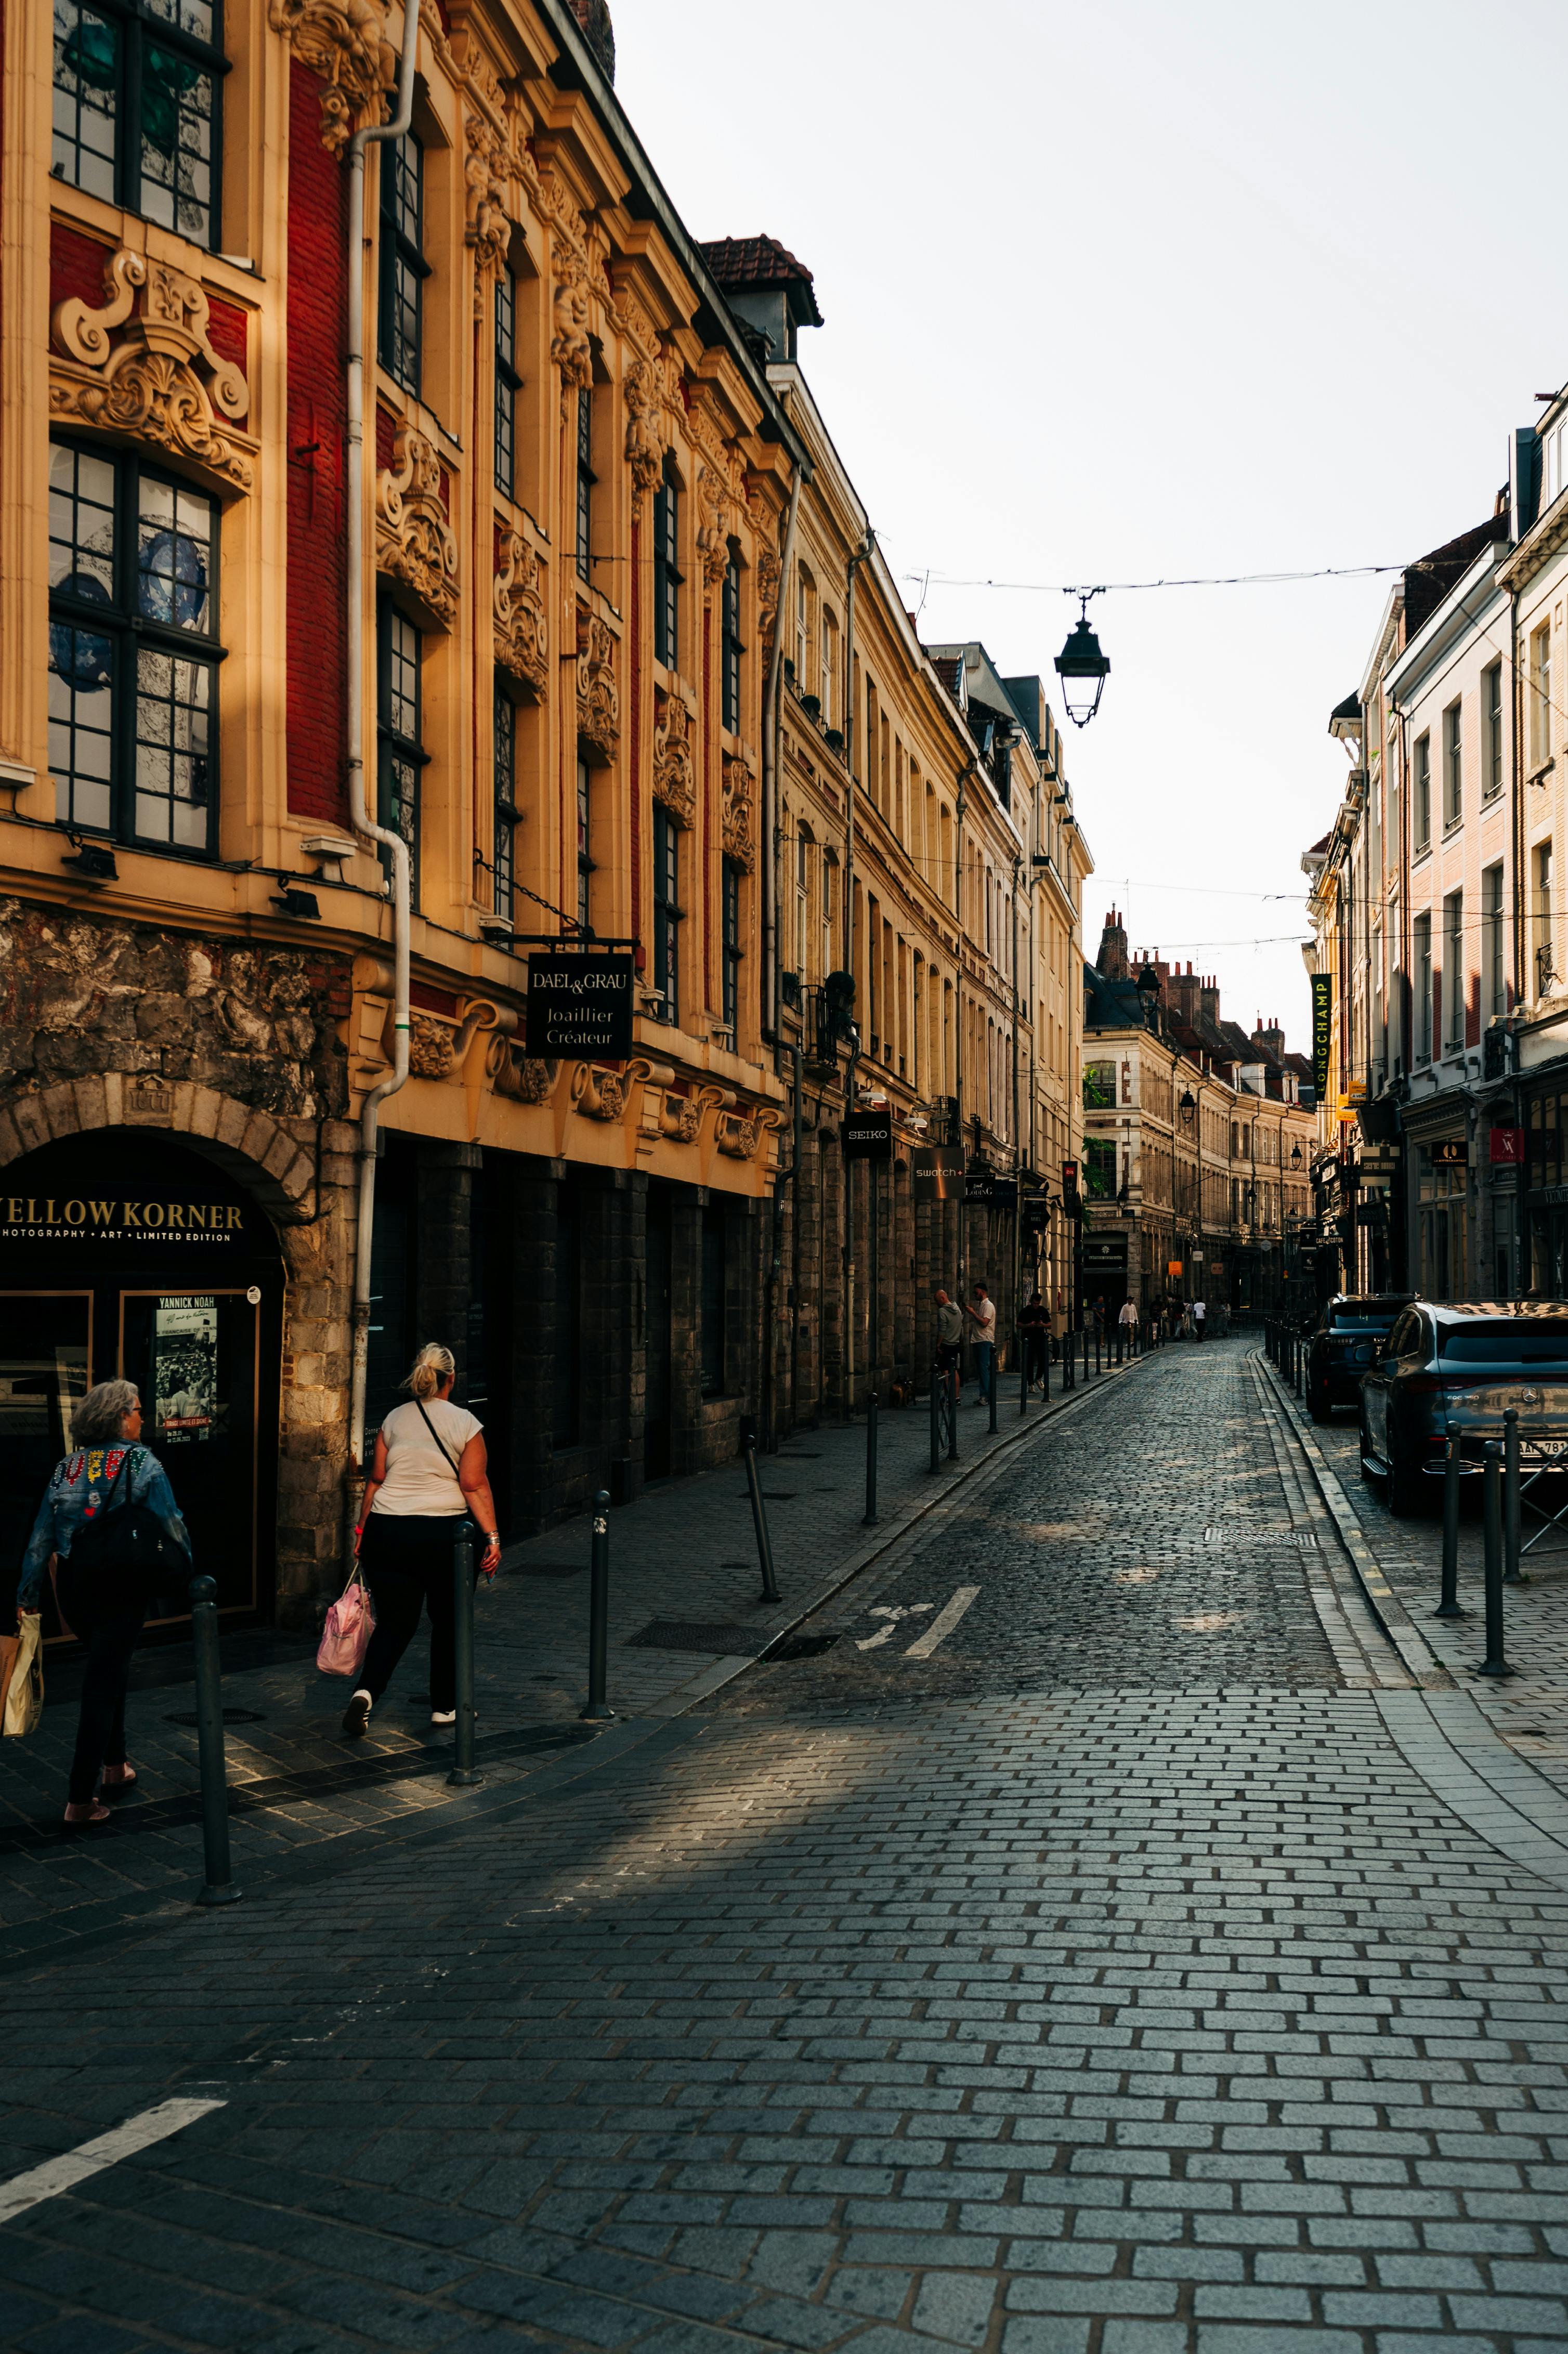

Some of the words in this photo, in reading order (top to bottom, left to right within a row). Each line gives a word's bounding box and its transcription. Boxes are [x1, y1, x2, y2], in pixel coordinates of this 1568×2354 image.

[547, 1008, 613, 1024] Joaillier
[547, 1029, 612, 1044] Créateur
[1316, 983, 1328, 1092] LONGCHAMP
[848, 1130, 887, 1140] SEIKO
[916, 1169, 956, 1177] swatch
[2, 1228, 86, 1238] HOTOGRAPHY
[186, 1233, 230, 1241] EDITION
[159, 1297, 193, 1309] YANNICK
[194, 1296, 215, 1307] NOAH
